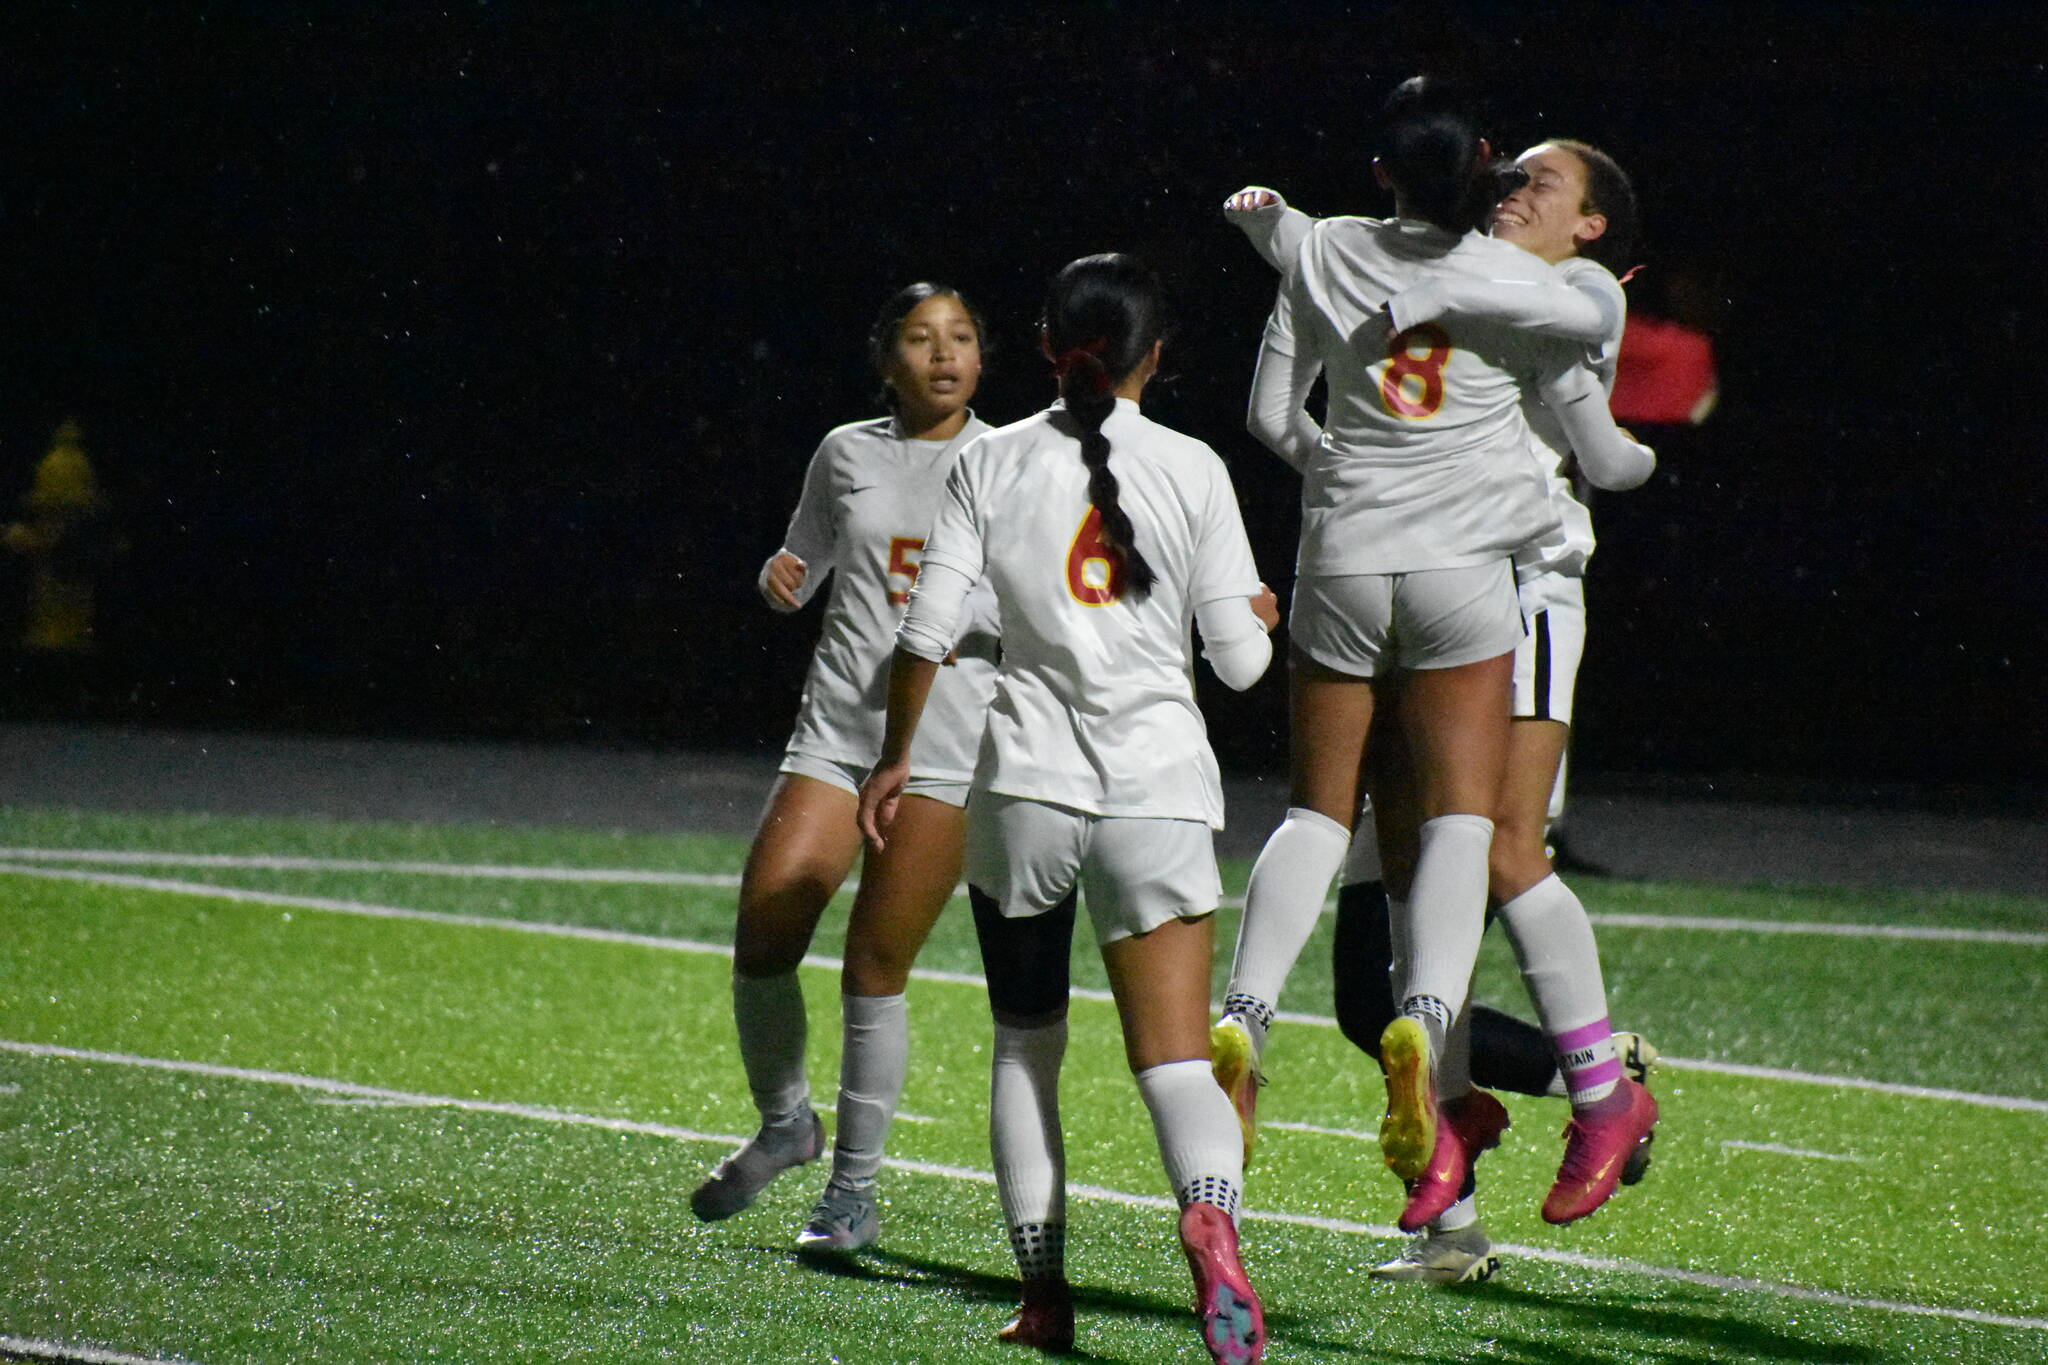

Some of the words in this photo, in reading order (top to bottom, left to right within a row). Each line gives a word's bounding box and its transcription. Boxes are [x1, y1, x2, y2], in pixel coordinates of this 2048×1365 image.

[1380, 322, 1453, 420] 8
[888, 536, 925, 605] 5
[1065, 503, 1128, 607] 6
